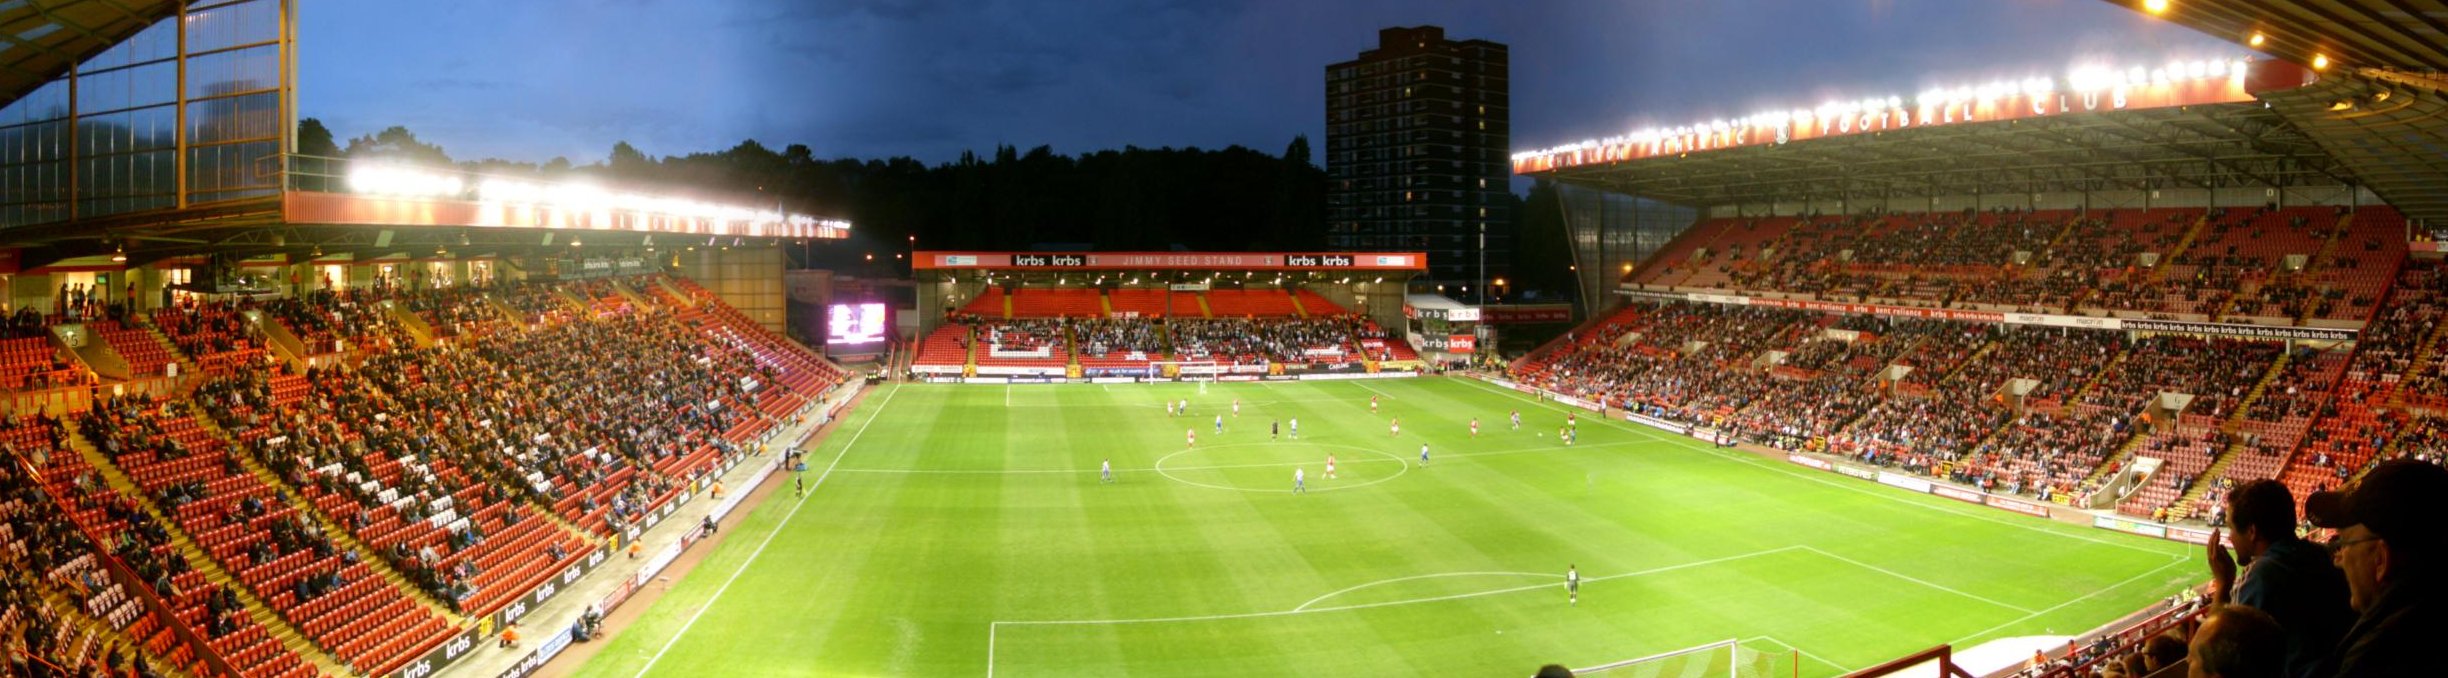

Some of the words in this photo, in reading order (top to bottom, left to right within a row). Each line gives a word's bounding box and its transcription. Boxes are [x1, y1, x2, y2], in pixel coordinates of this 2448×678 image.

[1016, 255, 1045, 266] krbs
[1052, 255, 1081, 266] krbs
[1122, 256, 1162, 266] JIMMY
[1167, 256, 1198, 266] SEED
[1204, 256, 1242, 266] STAND
[1289, 255, 1316, 266] krbs
[1322, 255, 1350, 266] krbs
[1417, 310, 1448, 320] krbs
[2137, 322, 2152, 330] krbs
[2153, 323, 2168, 331] krbs
[2220, 326, 2236, 334] krbs
[2238, 327, 2254, 335] krbs
[2257, 328, 2273, 336] krbs
[2275, 329, 2291, 337] krbs
[2293, 330, 2310, 338] krbs
[2311, 331, 2328, 339] krbs
[1422, 338, 1449, 350] krbs
[1450, 339, 1473, 350] krbs
[404, 660, 431, 678] krbs
[446, 636, 471, 660] krbs
[505, 602, 526, 624] krbs
[536, 583, 555, 603] krbs
[564, 566, 581, 584] krbs
[588, 550, 605, 567] krbs
[521, 655, 537, 674] krbs
